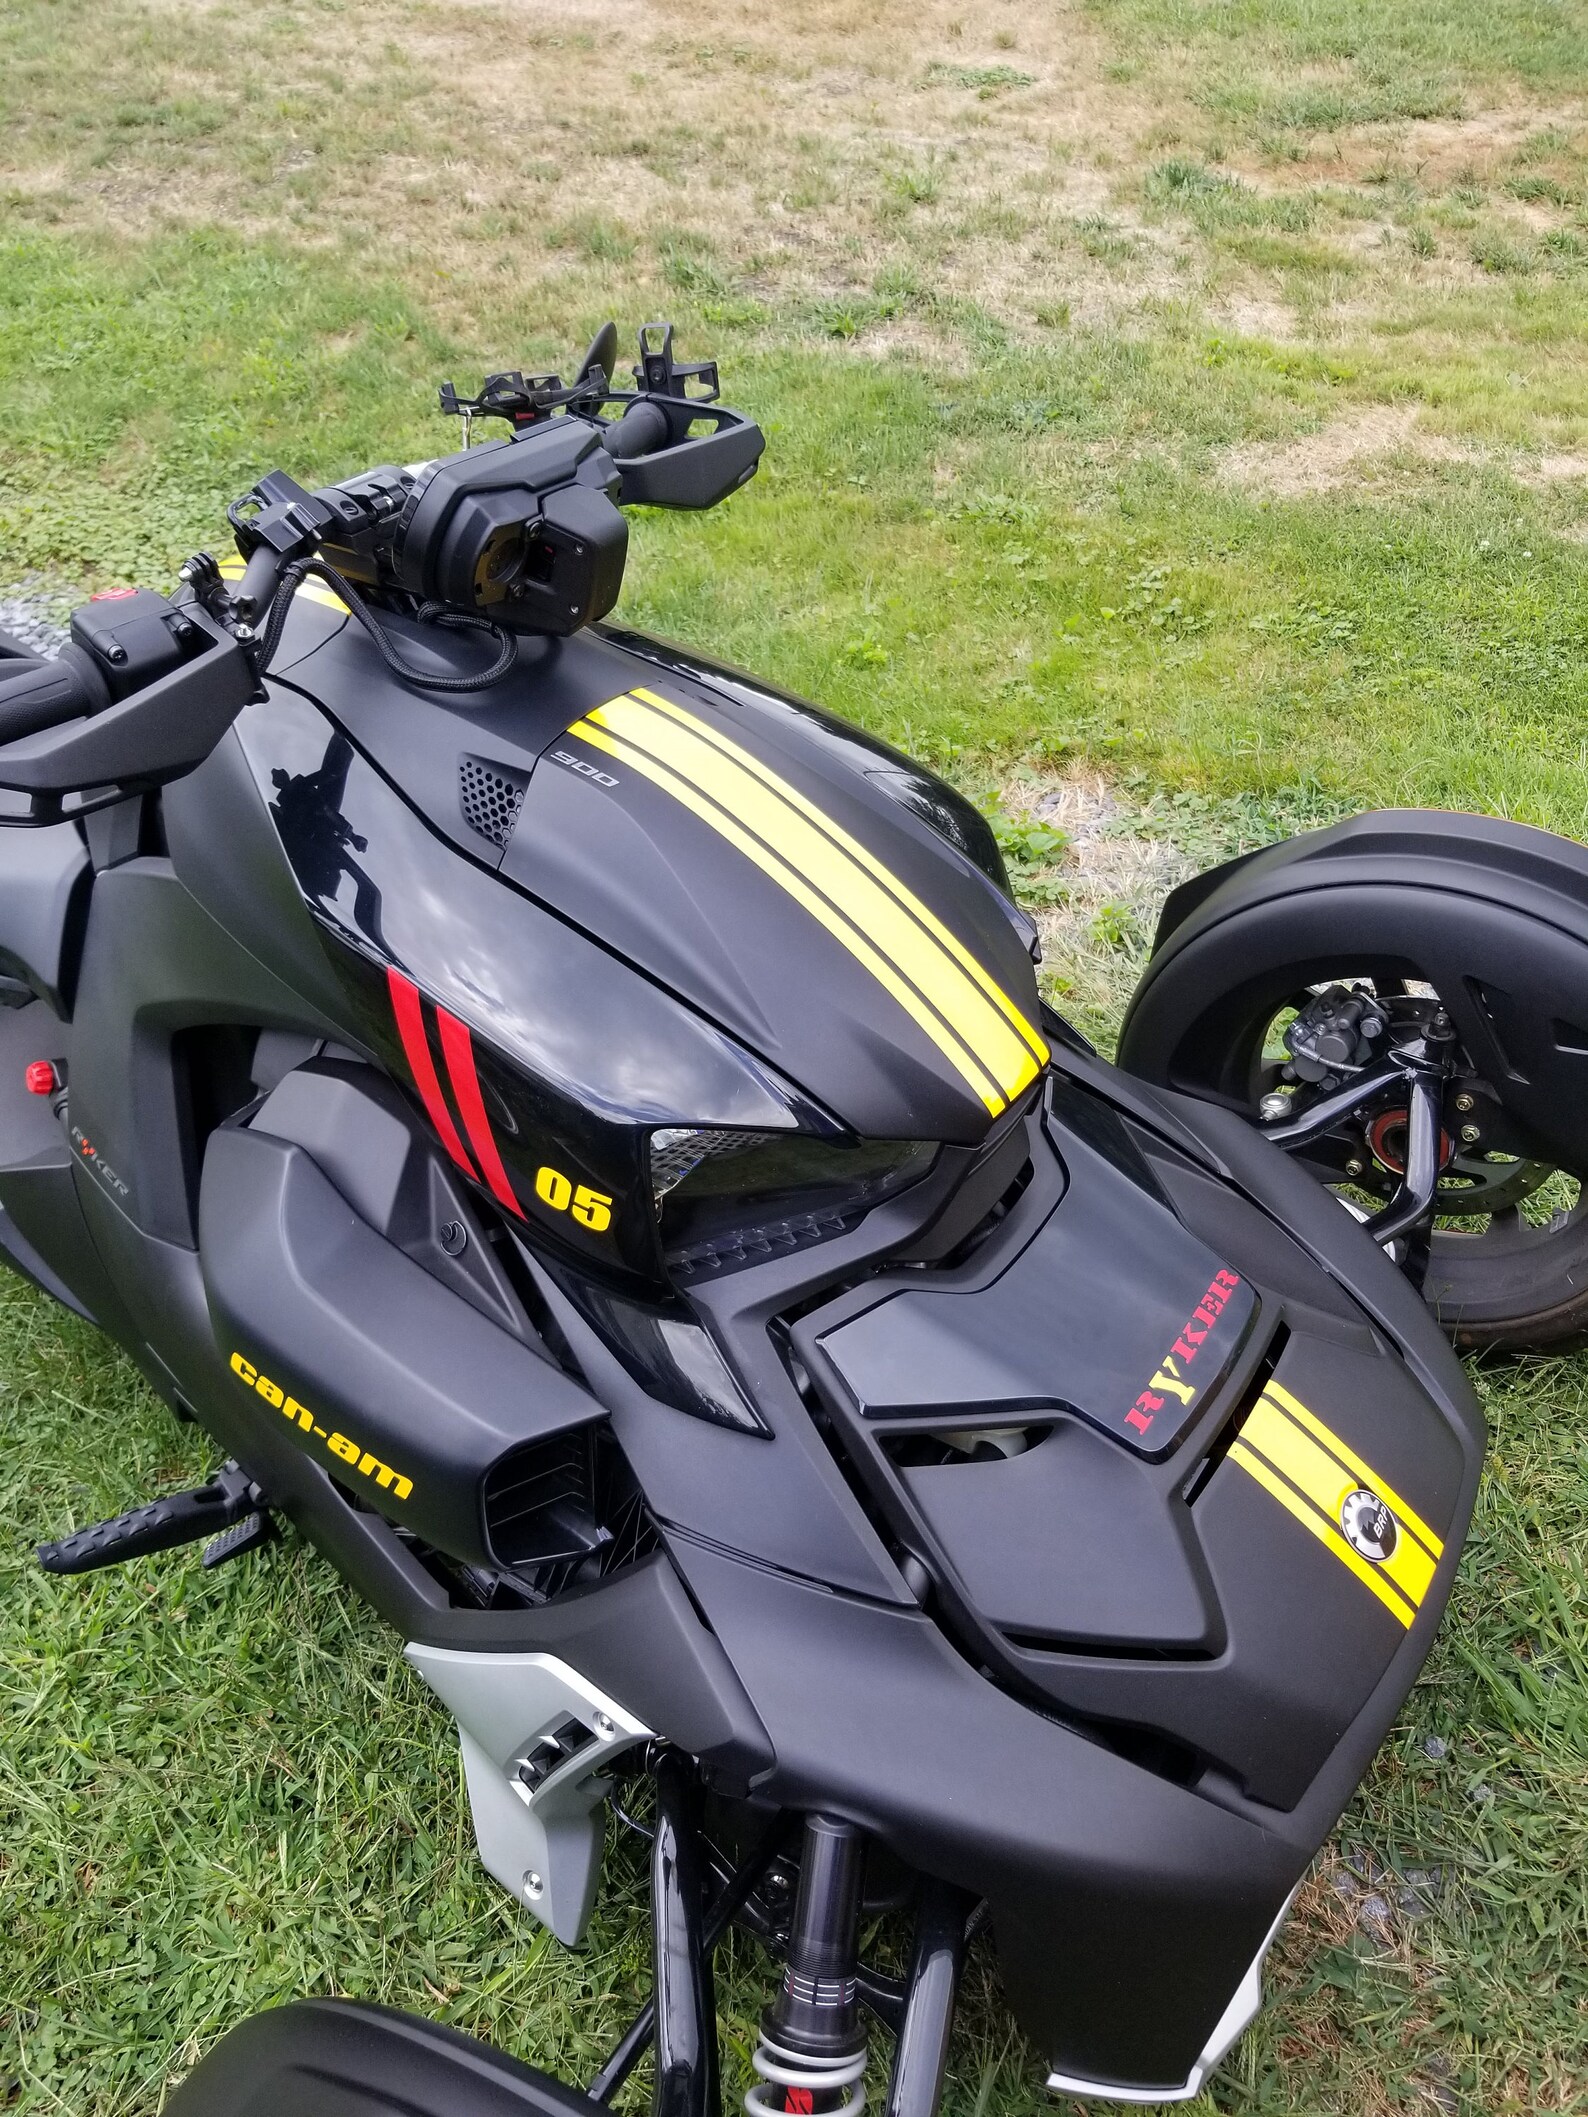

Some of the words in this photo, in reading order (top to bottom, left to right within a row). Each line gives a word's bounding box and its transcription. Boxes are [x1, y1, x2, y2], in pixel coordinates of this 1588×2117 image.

[550, 751, 620, 787] 900
[536, 1166, 613, 1232] 05
[1124, 1268, 1240, 1436] RYKER
[230, 1352, 413, 1500] can-am
[1373, 1505, 1388, 1539] BRP
